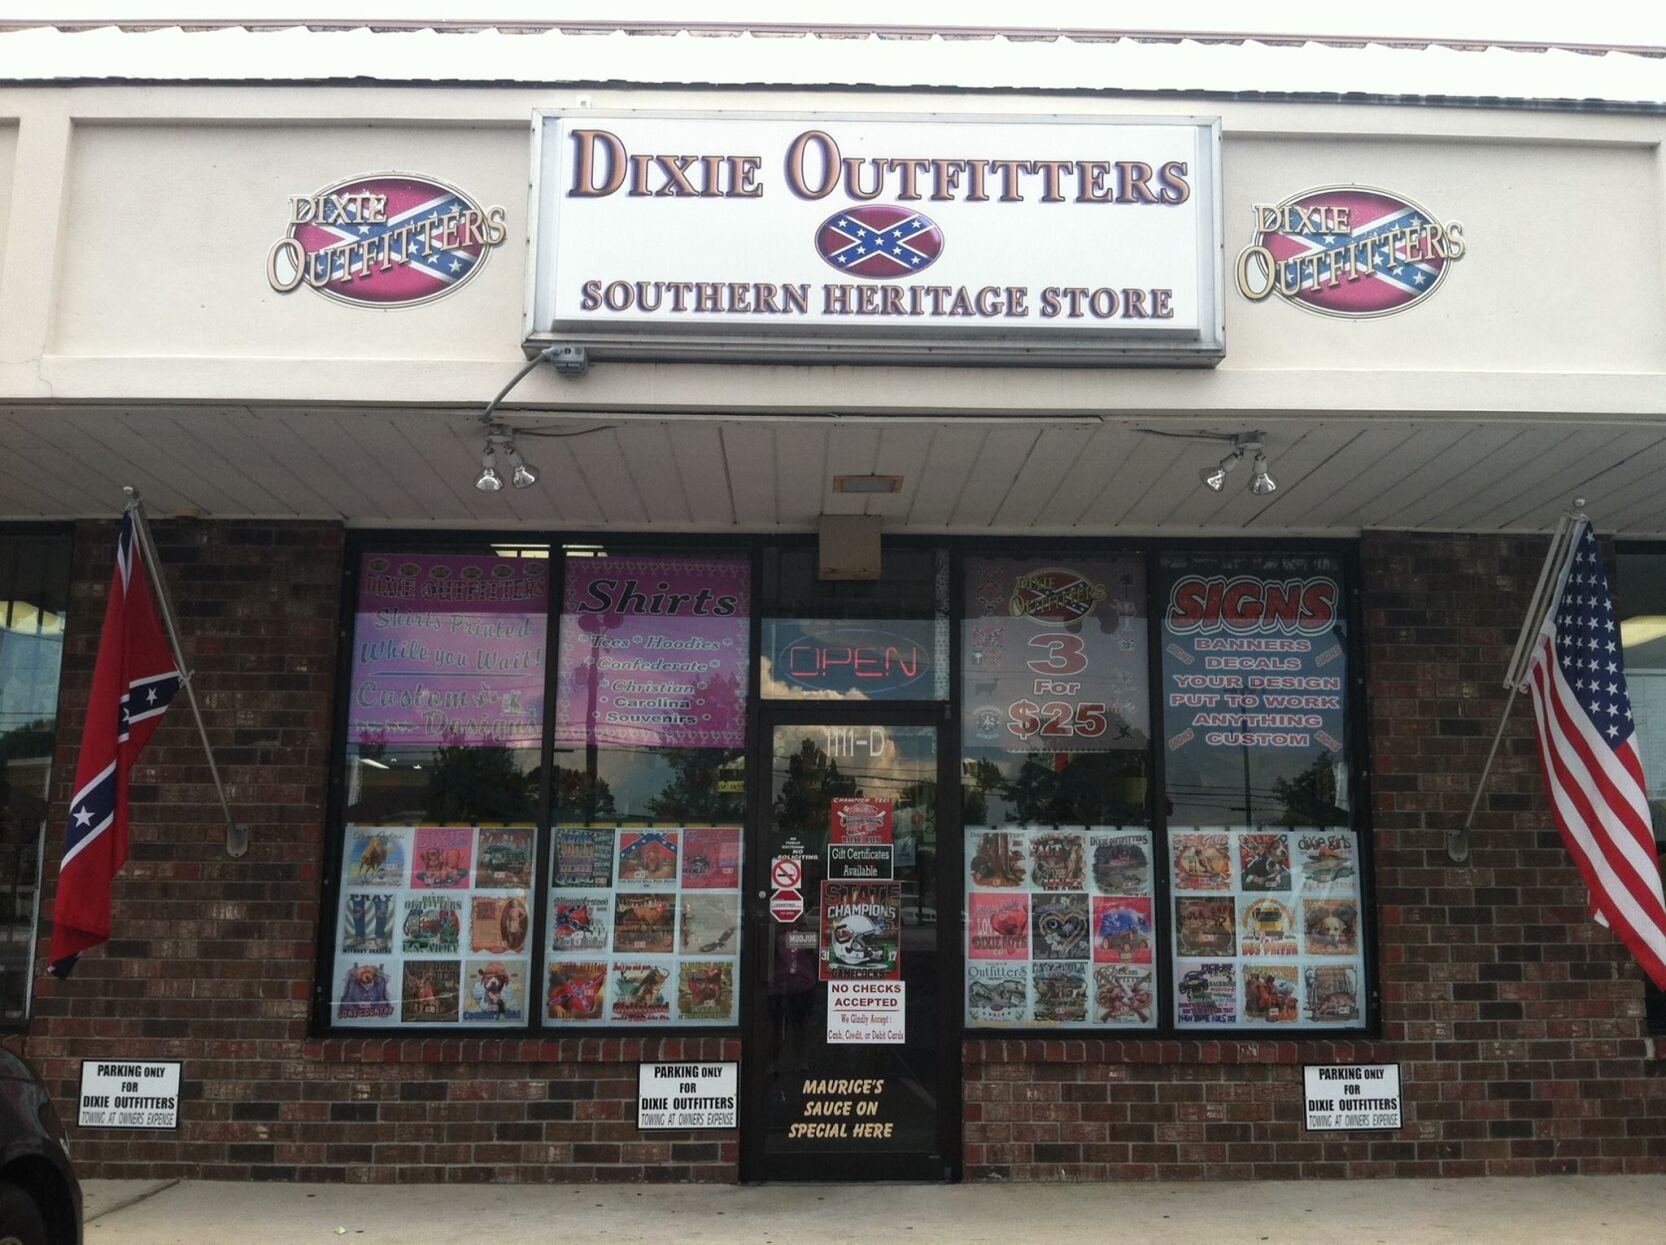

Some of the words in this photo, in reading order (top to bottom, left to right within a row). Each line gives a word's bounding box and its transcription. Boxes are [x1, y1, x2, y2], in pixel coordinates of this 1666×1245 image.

[568, 129, 765, 199] DIXIE
[784, 129, 1191, 206] OUTFITTERS
[288, 194, 389, 226] DIXIE
[1254, 203, 1352, 235] DIXIE
[265, 206, 508, 293] OUTFITTERS
[1236, 220, 1467, 302] OUTFITTERS
[582, 279, 811, 315] SOUTHERN
[822, 283, 1029, 317] HERITAGE
[1039, 285, 1174, 319] STORE
[578, 578, 738, 617] Shirts
[1167, 575, 1339, 636] SIGNS
[375, 608, 441, 630] Shirts
[450, 614, 533, 639] Printed
[591, 635, 630, 649] Tees
[646, 636, 720, 650] Hoodies
[1194, 638, 1311, 652] BANNERS
[360, 639, 429, 663] While
[434, 648, 467, 667] you
[477, 648, 545, 670] Wait!
[790, 646, 917, 676] OPEN
[1027, 633, 1088, 676] 3
[596, 656, 708, 673] Confederate
[1206, 656, 1302, 670] DECALS
[611, 680, 696, 695] Christian
[1034, 679, 1080, 695] For
[1173, 675, 1243, 689] YOUR
[1248, 677, 1340, 690] DESIGN
[358, 681, 468, 709] Custom
[1170, 694, 1220, 707] PUT
[1224, 695, 1259, 708] TO
[1264, 696, 1340, 709] WORK
[614, 697, 691, 709] Carolina
[606, 711, 697, 724] Souvenirs
[1007, 699, 1107, 740] $25
[1192, 713, 1322, 727] ANYTHING
[1206, 732, 1310, 746] CUSTOM
[832, 848, 847, 859] Gift
[847, 848, 890, 860] Certificates
[843, 865, 878, 877] Available
[825, 883, 900, 906] STATE
[827, 903, 897, 919] CHAMPIONS
[888, 951, 897, 961] 17
[832, 969, 885, 978] GAMECOCKS
[968, 966, 1028, 978] Outfitters
[832, 984, 849, 993] NO
[853, 984, 901, 993] CHECKS
[835, 998, 898, 1007] ACCEPTED
[841, 1014, 850, 1023] We
[851, 1014, 869, 1025] Gladly
[872, 1031, 886, 1040] Debit
[887, 1031, 904, 1040] Cards
[97, 1064, 142, 1077] PARKING
[144, 1067, 166, 1078] ONLY
[654, 1066, 699, 1078] PARKING
[701, 1067, 723, 1078] ONLY
[1319, 1068, 1362, 1080] PARKING
[1364, 1069, 1384, 1080] ONLY
[121, 1082, 138, 1092] FOR
[680, 1083, 697, 1093] FOR
[802, 1080, 884, 1095] MAURICE'S
[1344, 1085, 1360, 1095] FOR
[83, 1096, 109, 1108] DIXIE
[114, 1096, 175, 1109] OUTFITTERS
[641, 1098, 668, 1110] DIXIE
[673, 1097, 734, 1110] OUTFITTERS
[804, 1101, 852, 1116] SAUCE
[856, 1102, 879, 1116] ON
[1309, 1100, 1334, 1111] DIXIE
[1339, 1098, 1398, 1111] OUTFITTERS
[81, 1112, 106, 1124] TOWING
[107, 1112, 116, 1124] AT
[119, 1112, 144, 1125] OWNERS
[147, 1113, 175, 1126] EXPENSE
[641, 1113, 665, 1126] TOWING
[667, 1113, 676, 1126] AT
[678, 1113, 704, 1126] OWNERS
[707, 1112, 734, 1126] EXPENSE
[1309, 1115, 1332, 1127] TOWING
[1334, 1115, 1342, 1127] AT
[1345, 1114, 1370, 1127] OWNERS
[1373, 1113, 1398, 1126] EXPENSE
[788, 1123, 848, 1139] SPECIAL
[852, 1123, 893, 1138] HERE
